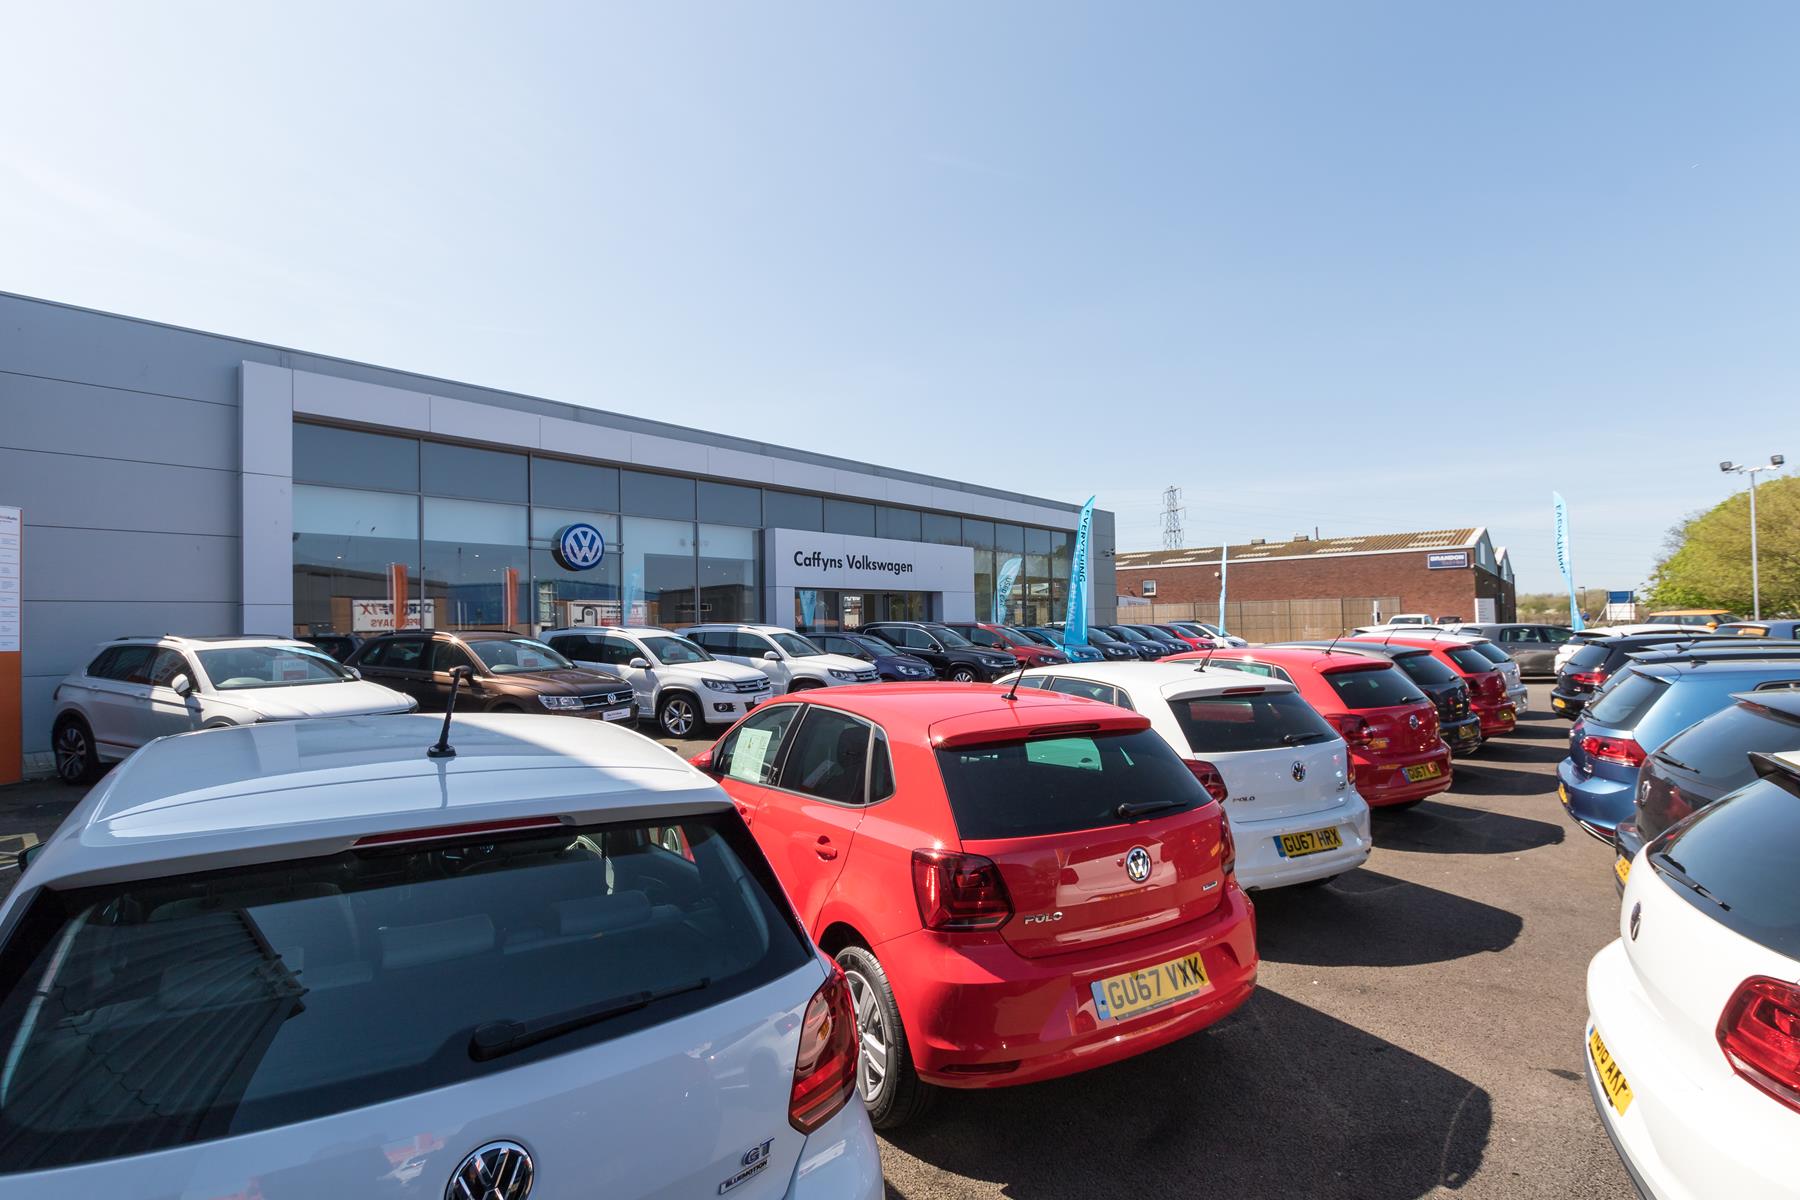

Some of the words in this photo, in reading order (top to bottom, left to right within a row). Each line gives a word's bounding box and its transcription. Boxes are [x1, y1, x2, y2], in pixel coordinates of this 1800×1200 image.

[1079, 509, 1091, 582] EVERYTHING
[793, 550, 842, 571] Caffyns
[846, 554, 913, 575] Volkswagen
[1283, 832, 1315, 852] GU67
[1316, 828, 1341, 847] HRX
[1024, 911, 1063, 925] POLO
[1107, 968, 1161, 1009] GU67
[1164, 956, 1205, 990] VXK
[743, 1137, 775, 1165] GT
